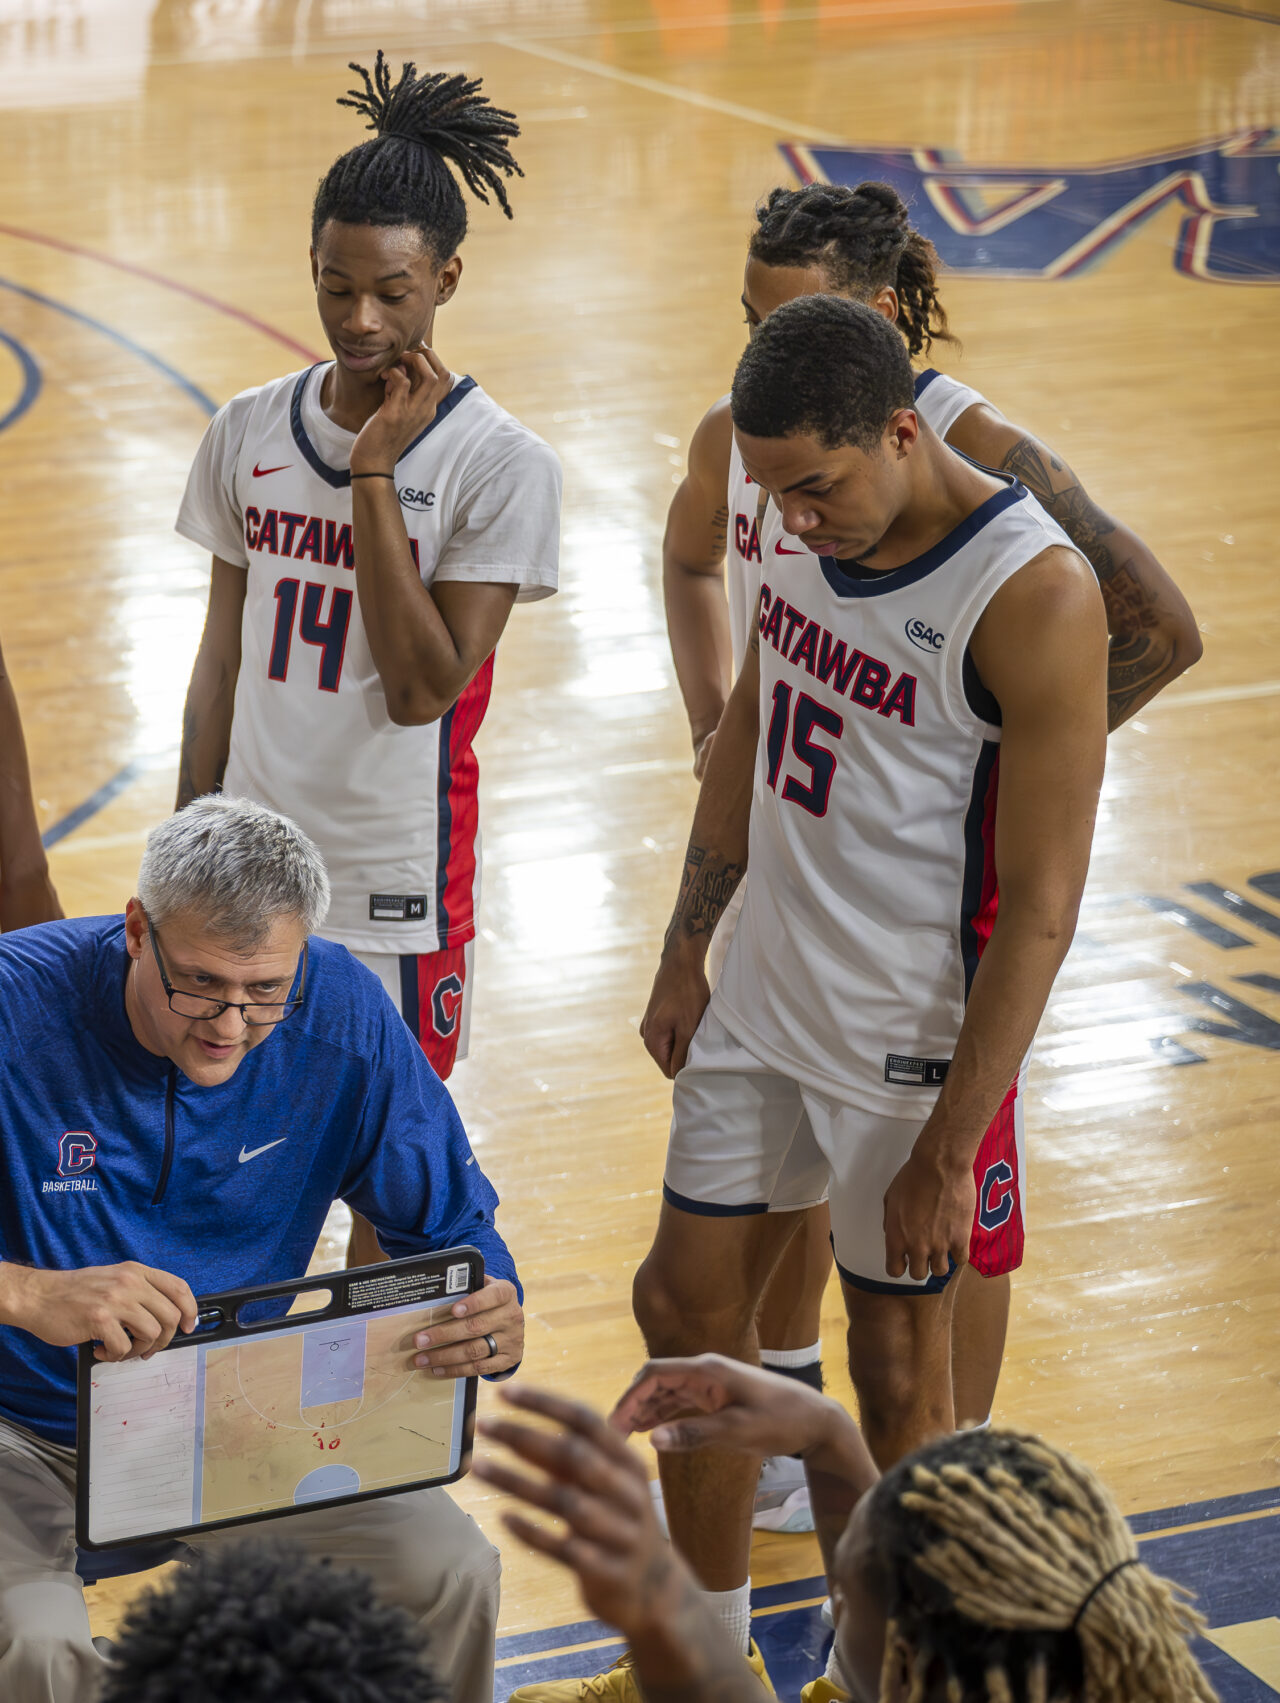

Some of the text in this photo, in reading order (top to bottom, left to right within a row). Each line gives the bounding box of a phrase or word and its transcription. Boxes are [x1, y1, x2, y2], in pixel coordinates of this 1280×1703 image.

[402, 487, 436, 507] SAC
[268, 577, 353, 693] 14
[758, 583, 917, 727] CATAWBA
[910, 620, 945, 650] SAC
[767, 680, 843, 818] 15
[410, 903, 421, 915] M
[431, 972, 463, 1038] C
[933, 1068, 941, 1080] L
[57, 1131, 98, 1177] C
[42, 1179, 98, 1192] BASKETBALL
[979, 1158, 1014, 1231] C
